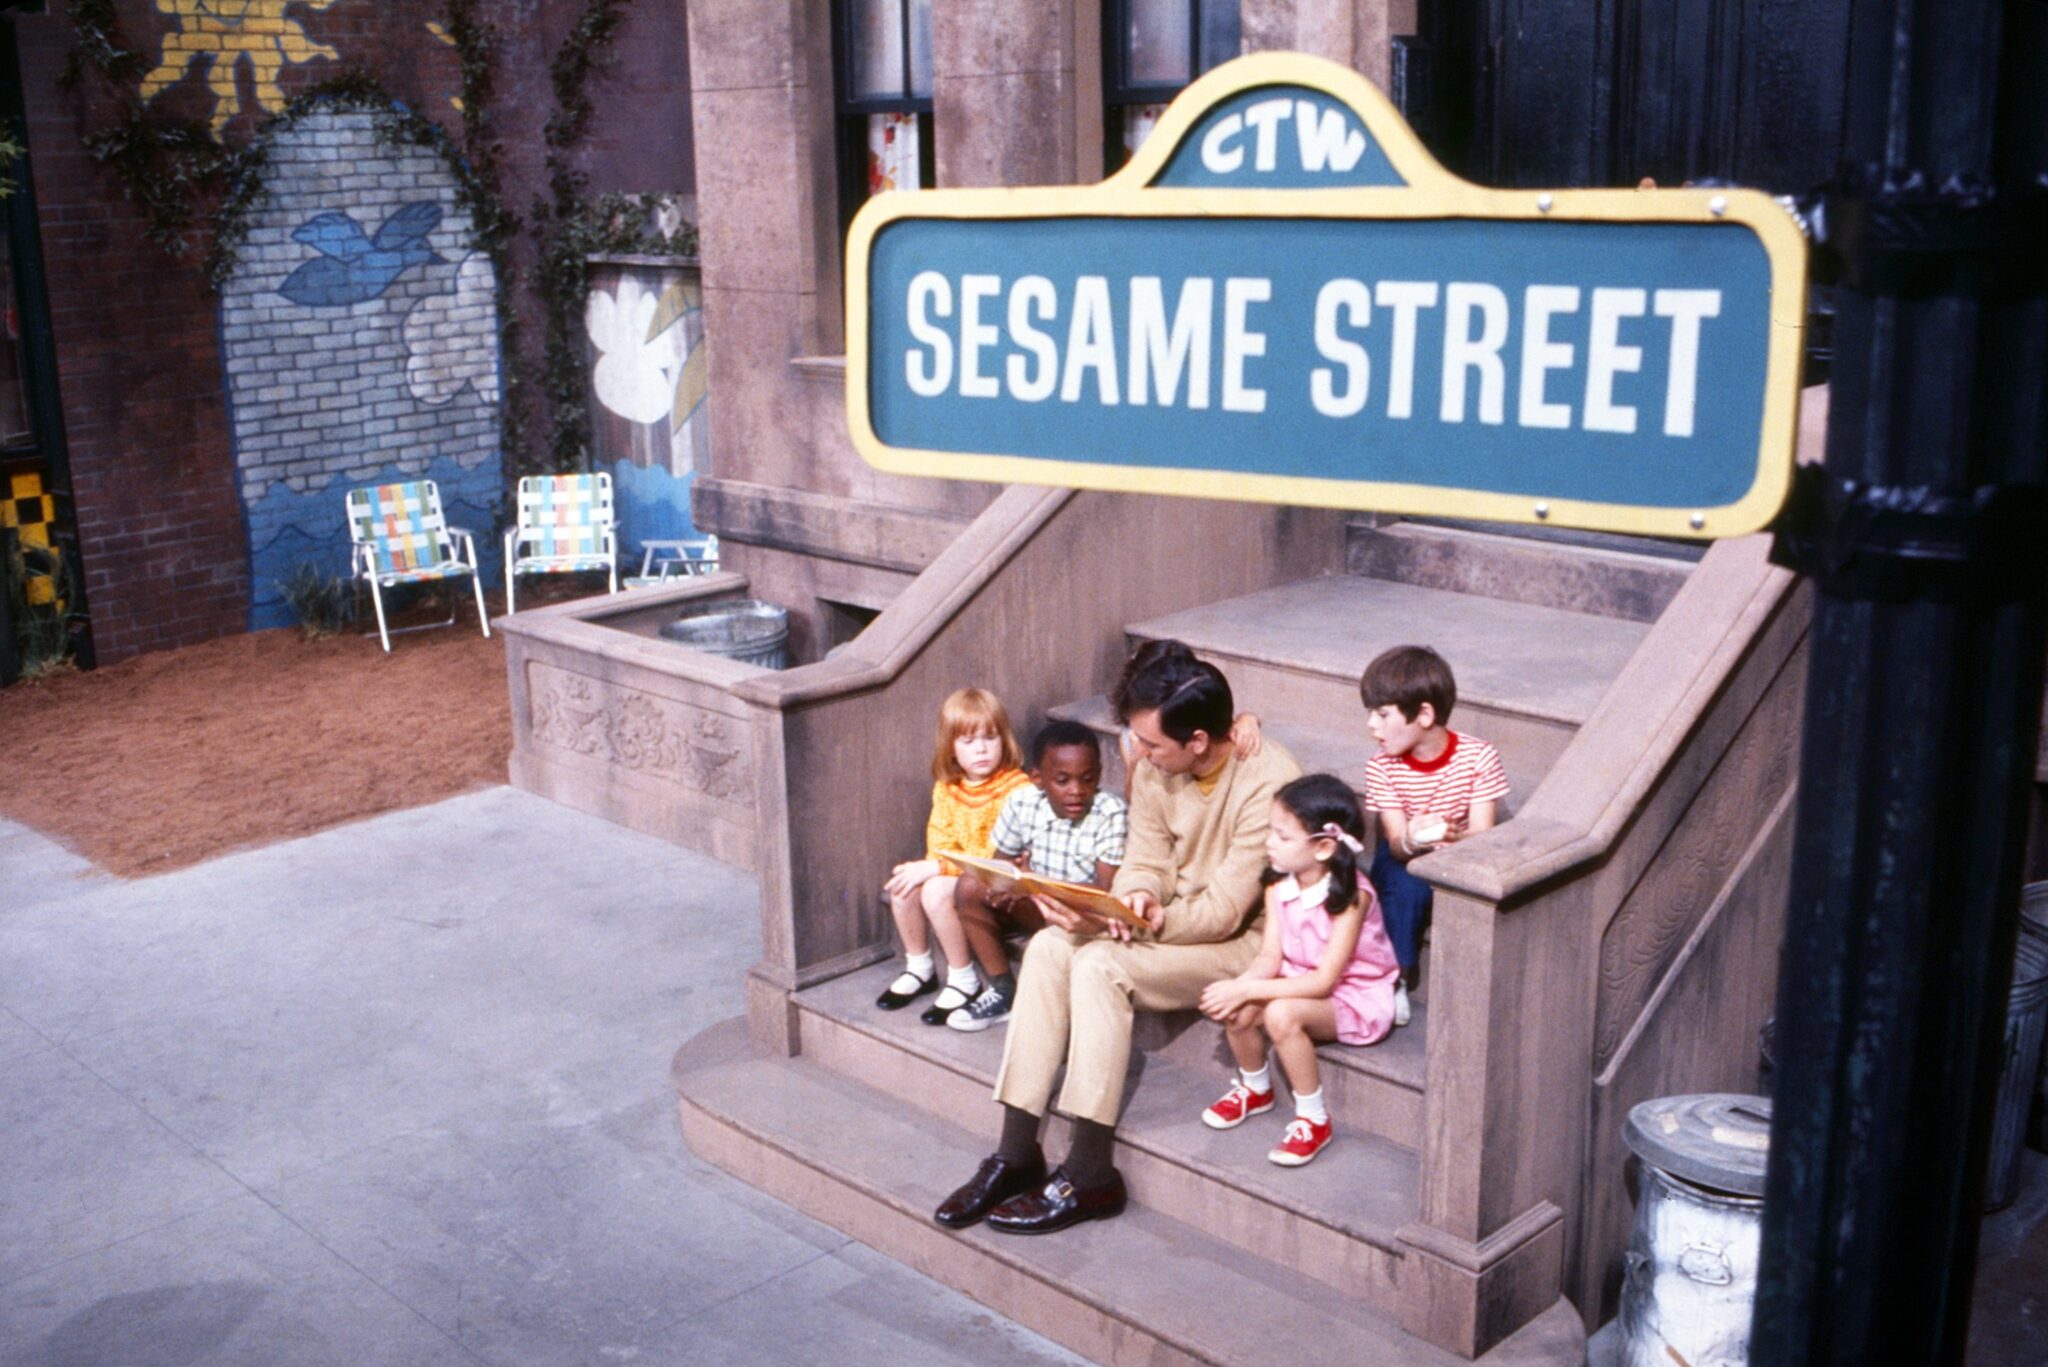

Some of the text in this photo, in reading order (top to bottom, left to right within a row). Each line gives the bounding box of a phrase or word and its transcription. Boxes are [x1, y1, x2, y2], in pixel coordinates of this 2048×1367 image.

[1201, 98, 1366, 174] CTW
[905, 270, 1721, 437] SESAME STREET
